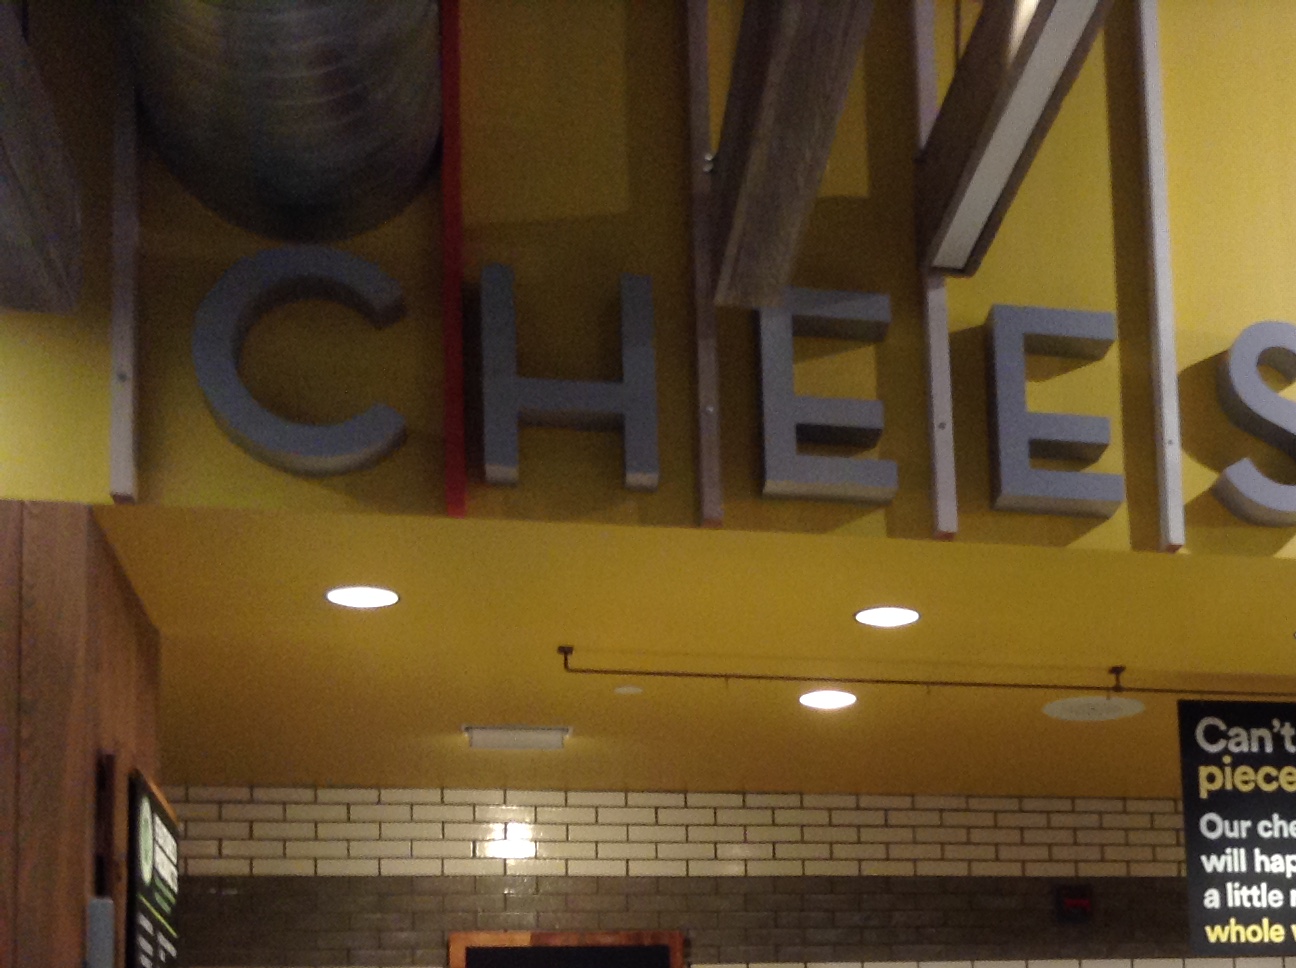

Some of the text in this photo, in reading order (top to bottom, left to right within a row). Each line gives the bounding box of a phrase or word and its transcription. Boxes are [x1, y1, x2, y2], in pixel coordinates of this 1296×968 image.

[1195, 716, 1296, 753] Can't
[1199, 812, 1252, 839] Our
[1200, 848, 1247, 875] will
[1203, 888, 1221, 908] a
[1226, 883, 1284, 908] little
[1205, 918, 1286, 943] whole
